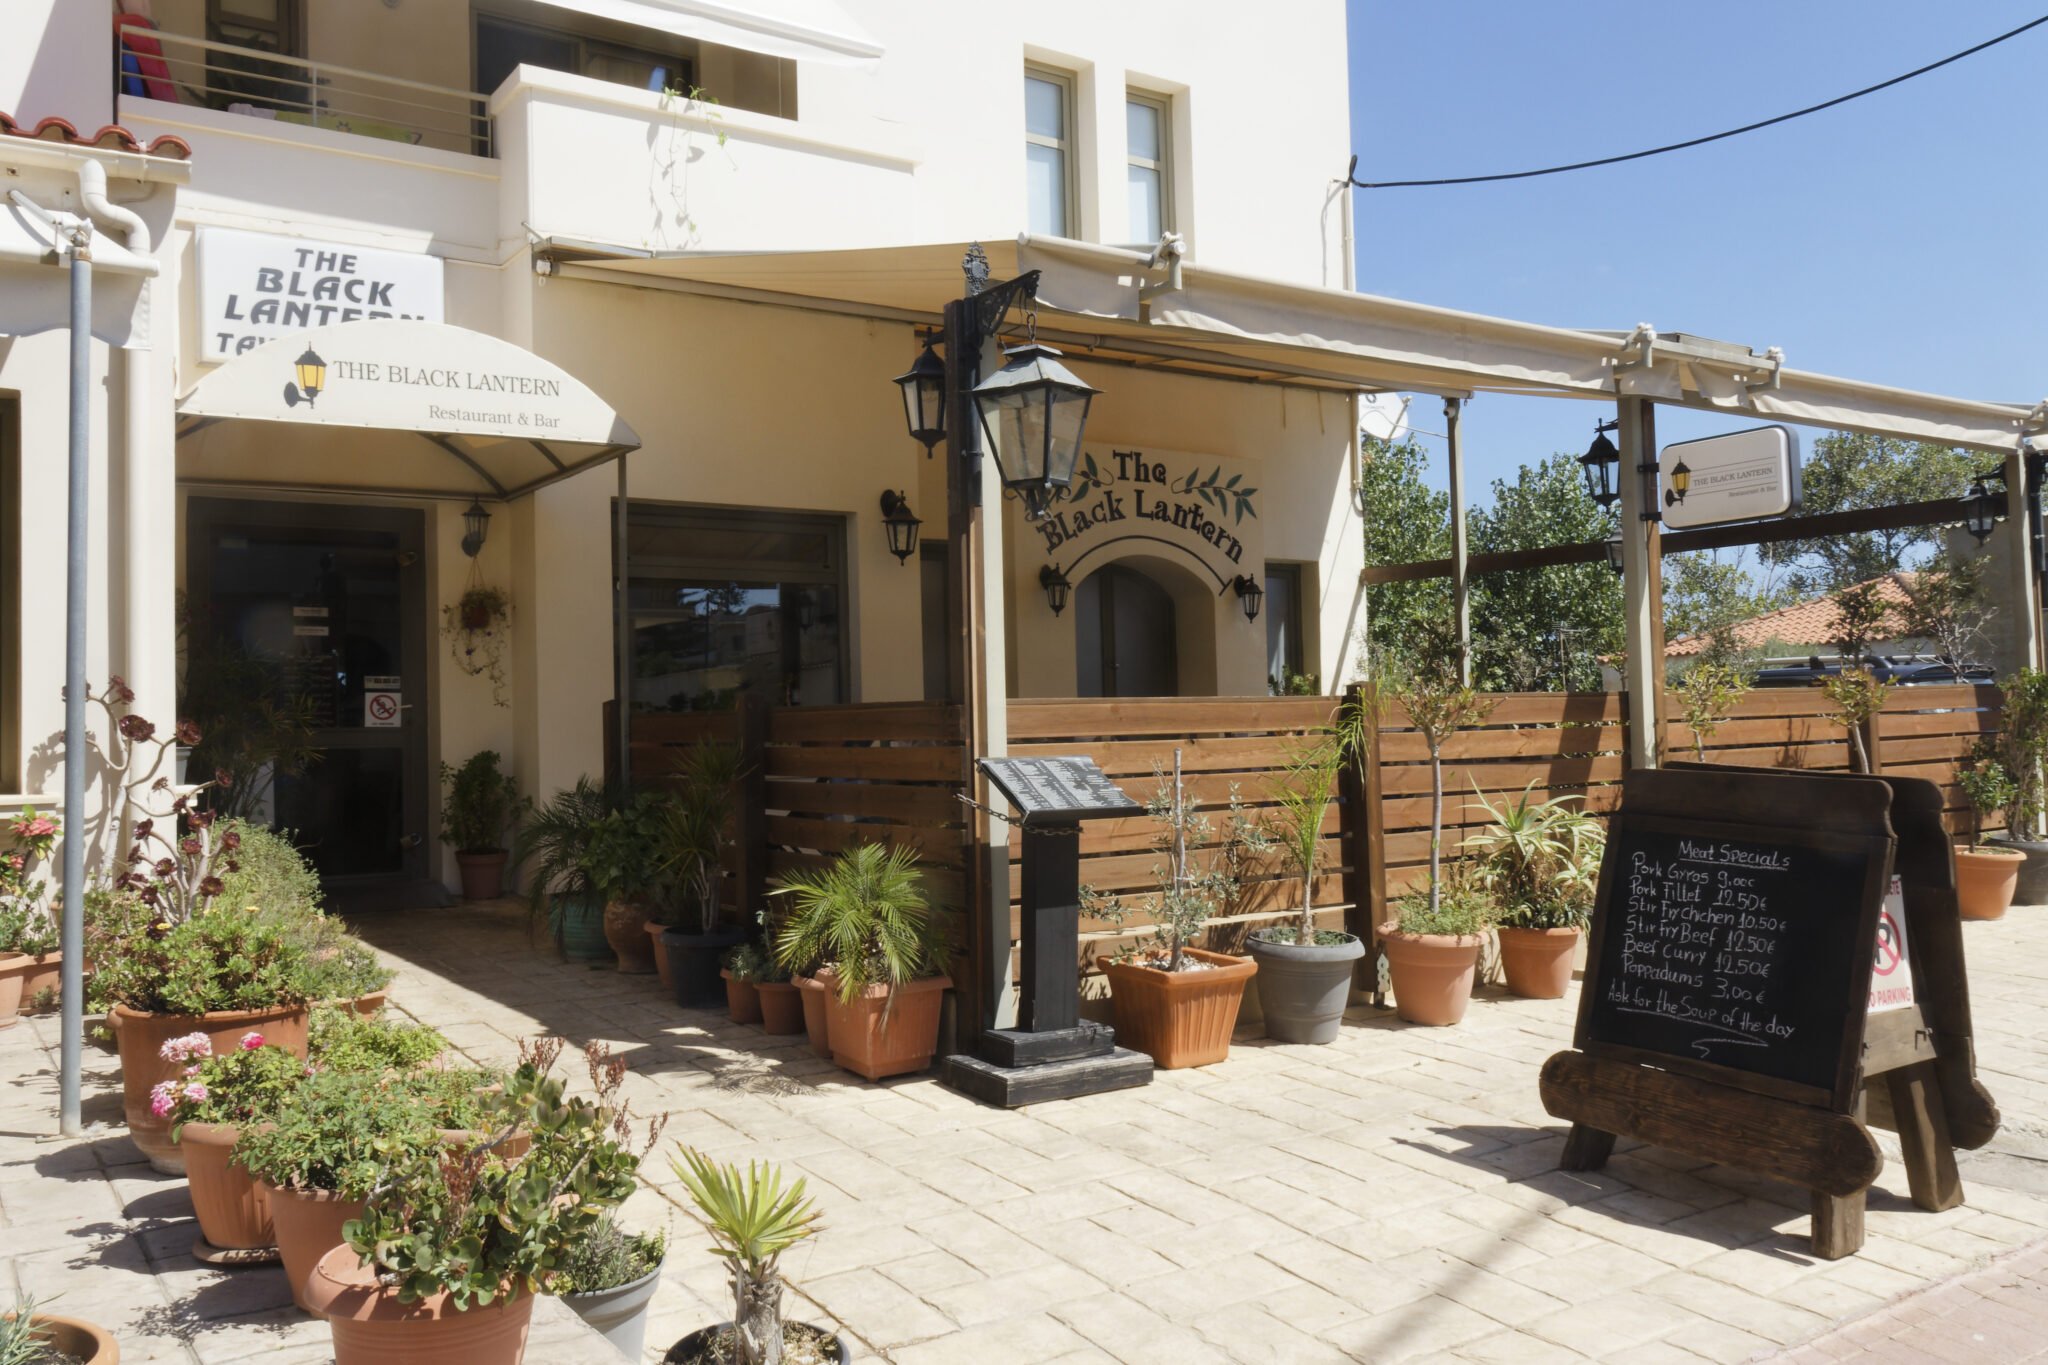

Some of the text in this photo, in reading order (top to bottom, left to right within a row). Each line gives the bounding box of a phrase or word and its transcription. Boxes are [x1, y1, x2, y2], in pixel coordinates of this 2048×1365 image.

[295, 247, 358, 275] THE
[255, 266, 395, 307] BLACK
[333, 360, 561, 397] THE BLACK LANTERN
[428, 404, 561, 429] Restaurant & Bar
[1112, 450, 1167, 486] The
[1693, 466, 1774, 487] THE BLACK LANTERN
[1035, 489, 1243, 566] Black Lantern
[1679, 840, 1714, 860] Meat
[1632, 851, 1662, 878] Pork
[1667, 863, 1710, 885] Gyros
[1629, 875, 1657, 897] Pork
[1662, 881, 1702, 903] Fillet
[1627, 895, 1657, 913] Stir
[1661, 900, 1681, 921] Fry
[1625, 914, 1656, 934] Stir
[1659, 920, 1679, 940] Fry
[1680, 923, 1716, 948] Beef
[1622, 932, 1660, 955] Beef
[1662, 943, 1707, 966] Curry
[1608, 977, 1629, 1003] Ask
[1632, 985, 1652, 1008] for
[1656, 988, 1678, 1014] the
[1721, 1006, 1739, 1027] of
[1740, 1011, 1763, 1032] the
[1764, 1014, 1796, 1039] day
[1878, 986, 1911, 1006] PARKING
